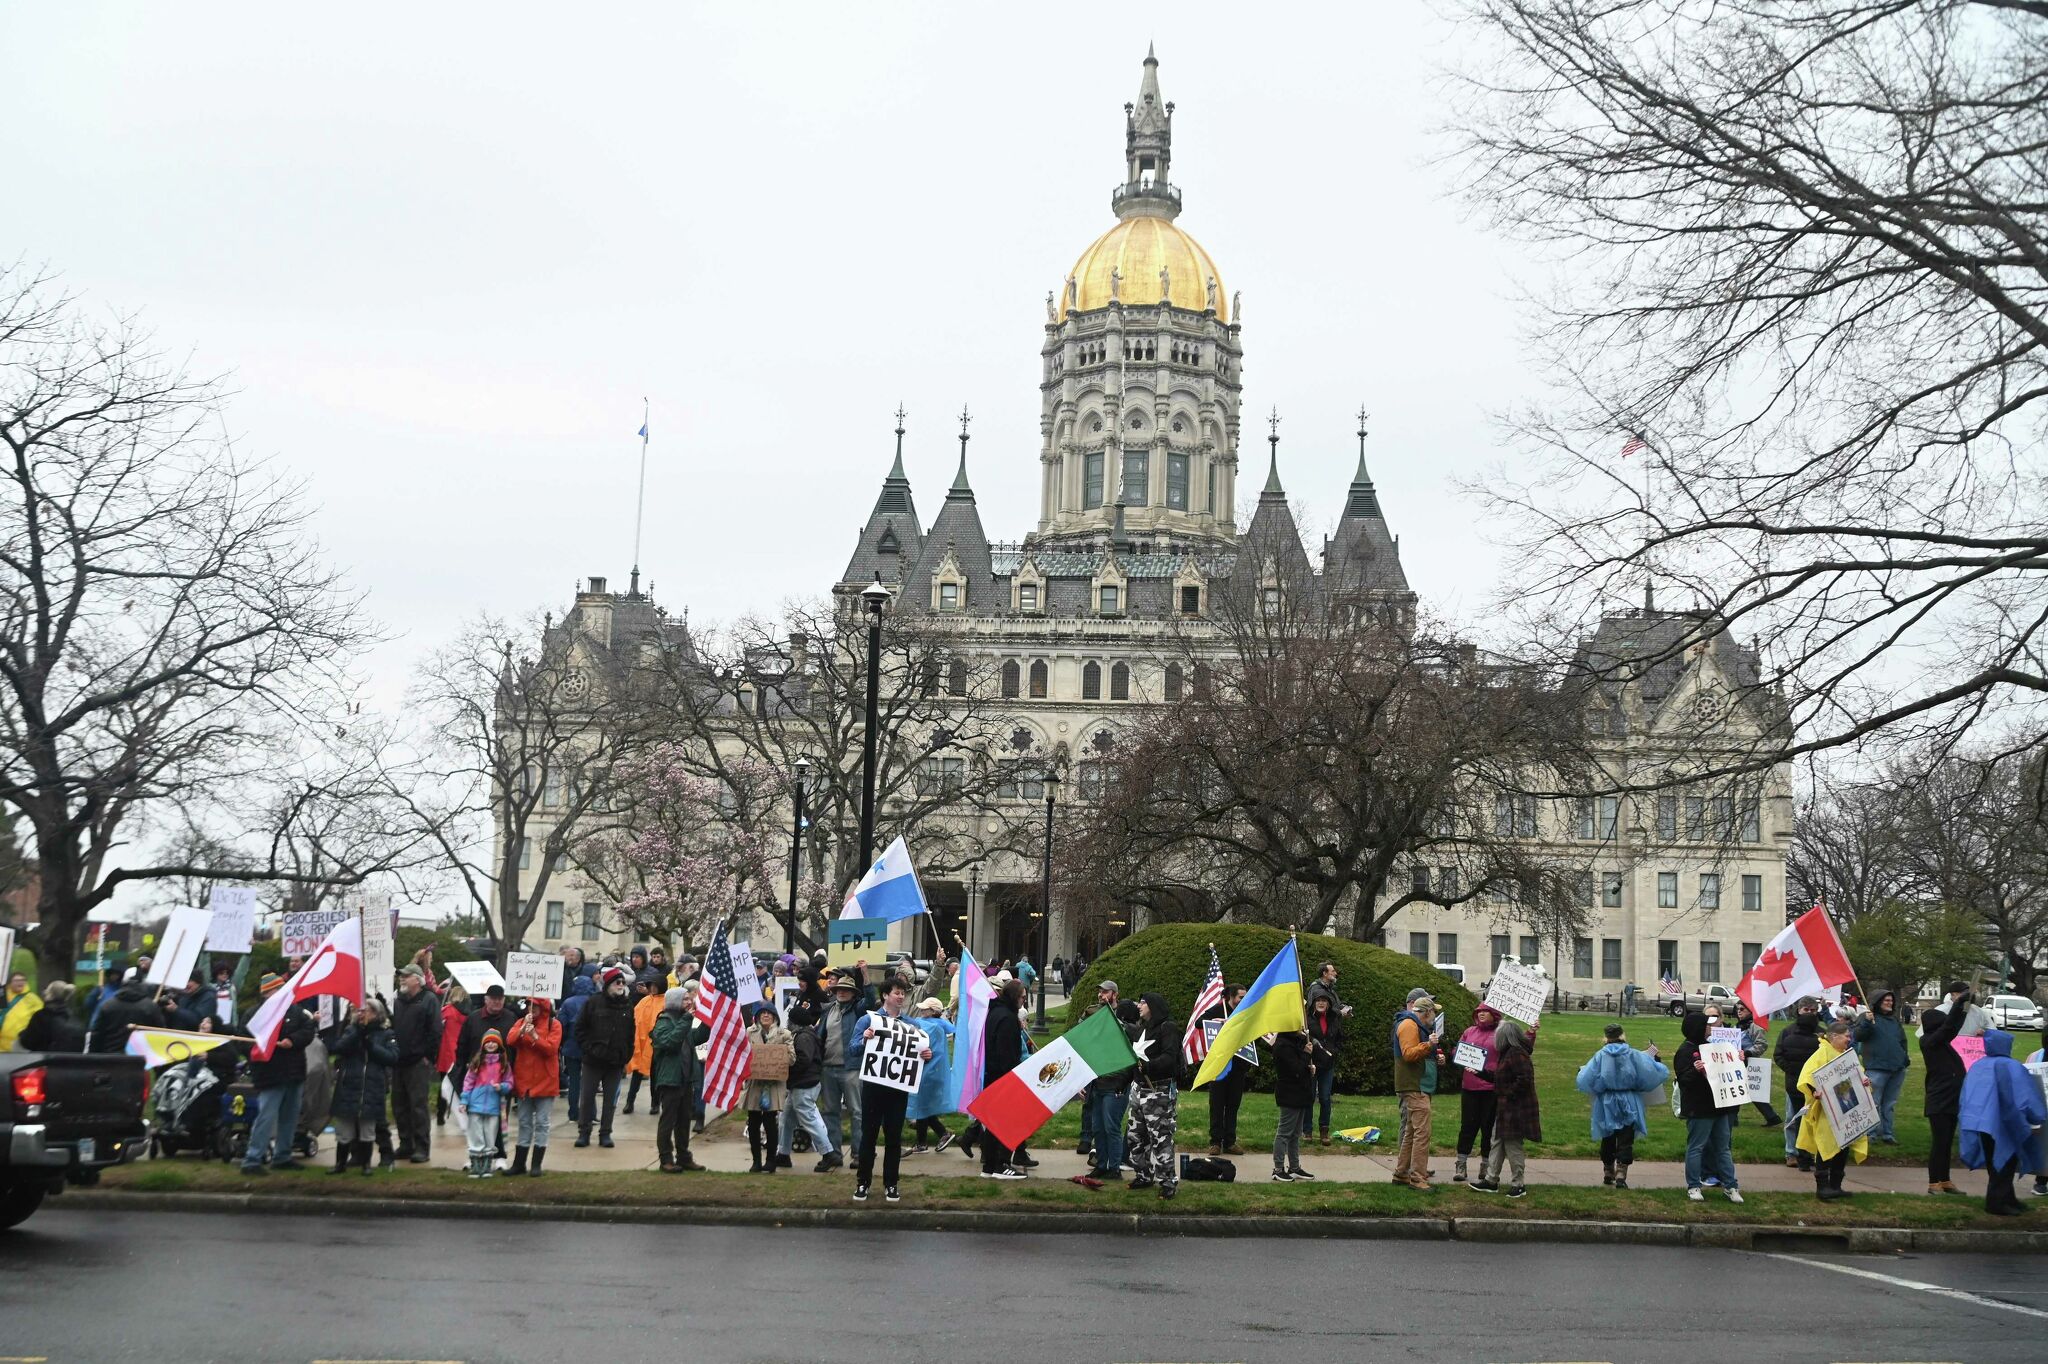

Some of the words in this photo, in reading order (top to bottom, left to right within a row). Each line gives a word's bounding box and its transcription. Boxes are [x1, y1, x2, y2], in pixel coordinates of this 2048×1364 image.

[284, 911, 346, 925] GROCERIES
[841, 932, 876, 951] FDT
[873, 1029, 920, 1059] THE
[1711, 1051, 1734, 1064] OPEN
[863, 1053, 919, 1086] RICH
[1845, 1111, 1868, 1131] KINGS
